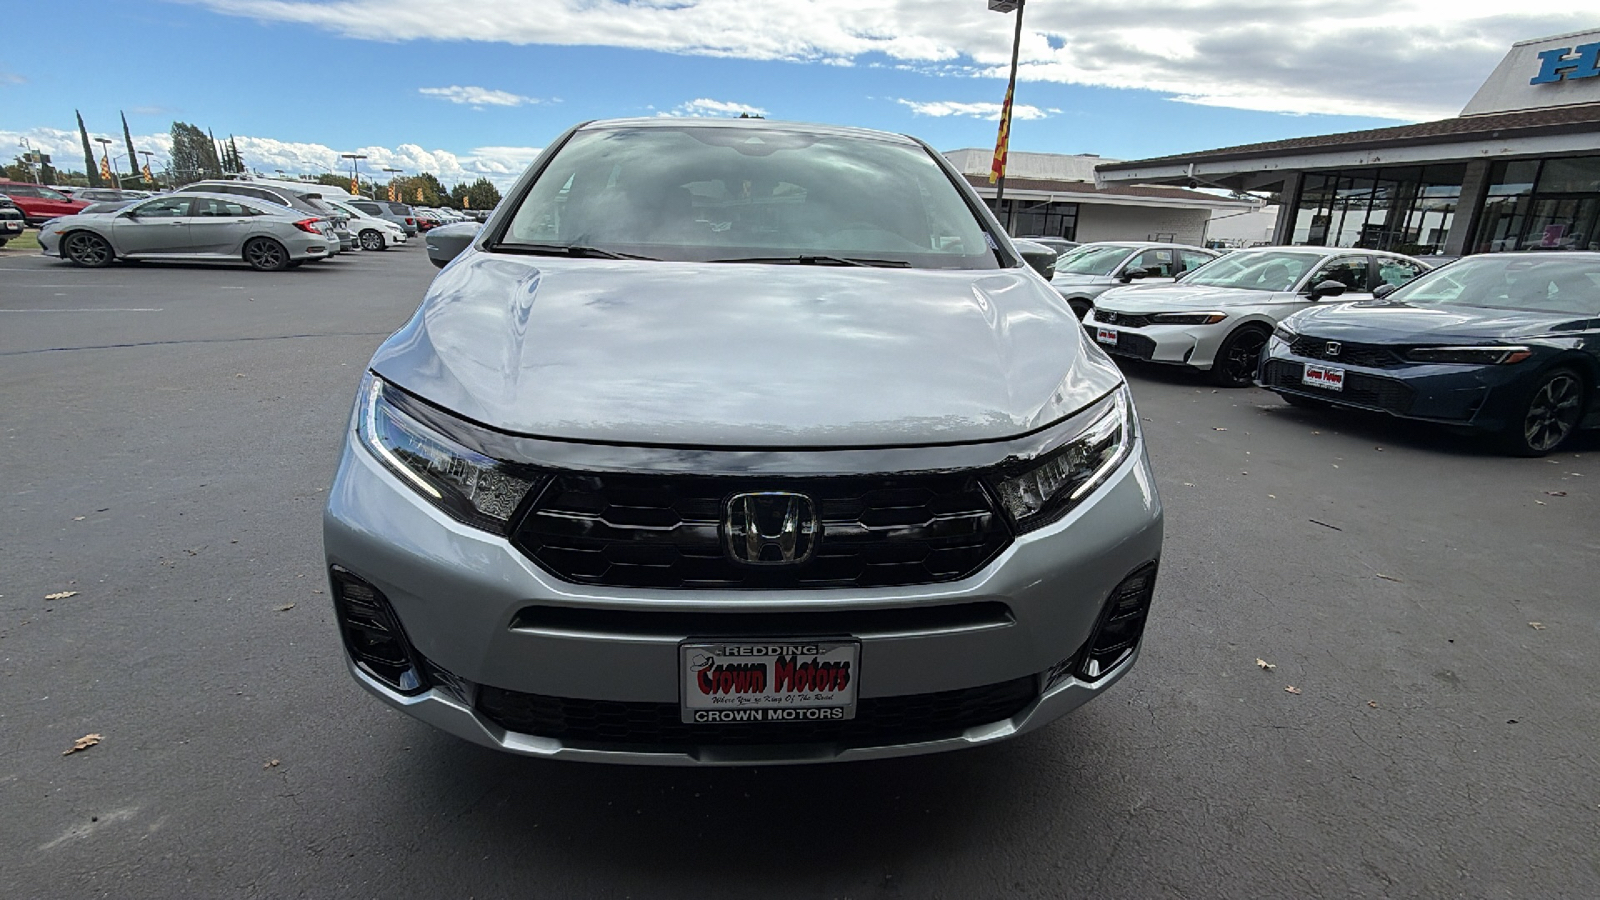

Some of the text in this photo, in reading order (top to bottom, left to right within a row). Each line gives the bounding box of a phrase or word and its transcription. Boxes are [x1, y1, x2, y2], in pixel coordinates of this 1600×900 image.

[725, 645, 818, 656] REDDING
[696, 655, 850, 695] Crown Motors
[763, 695, 782, 703] King
[784, 694, 796, 703] Of
[797, 694, 811, 702] The
[695, 708, 843, 722] CROWN MOTORS
